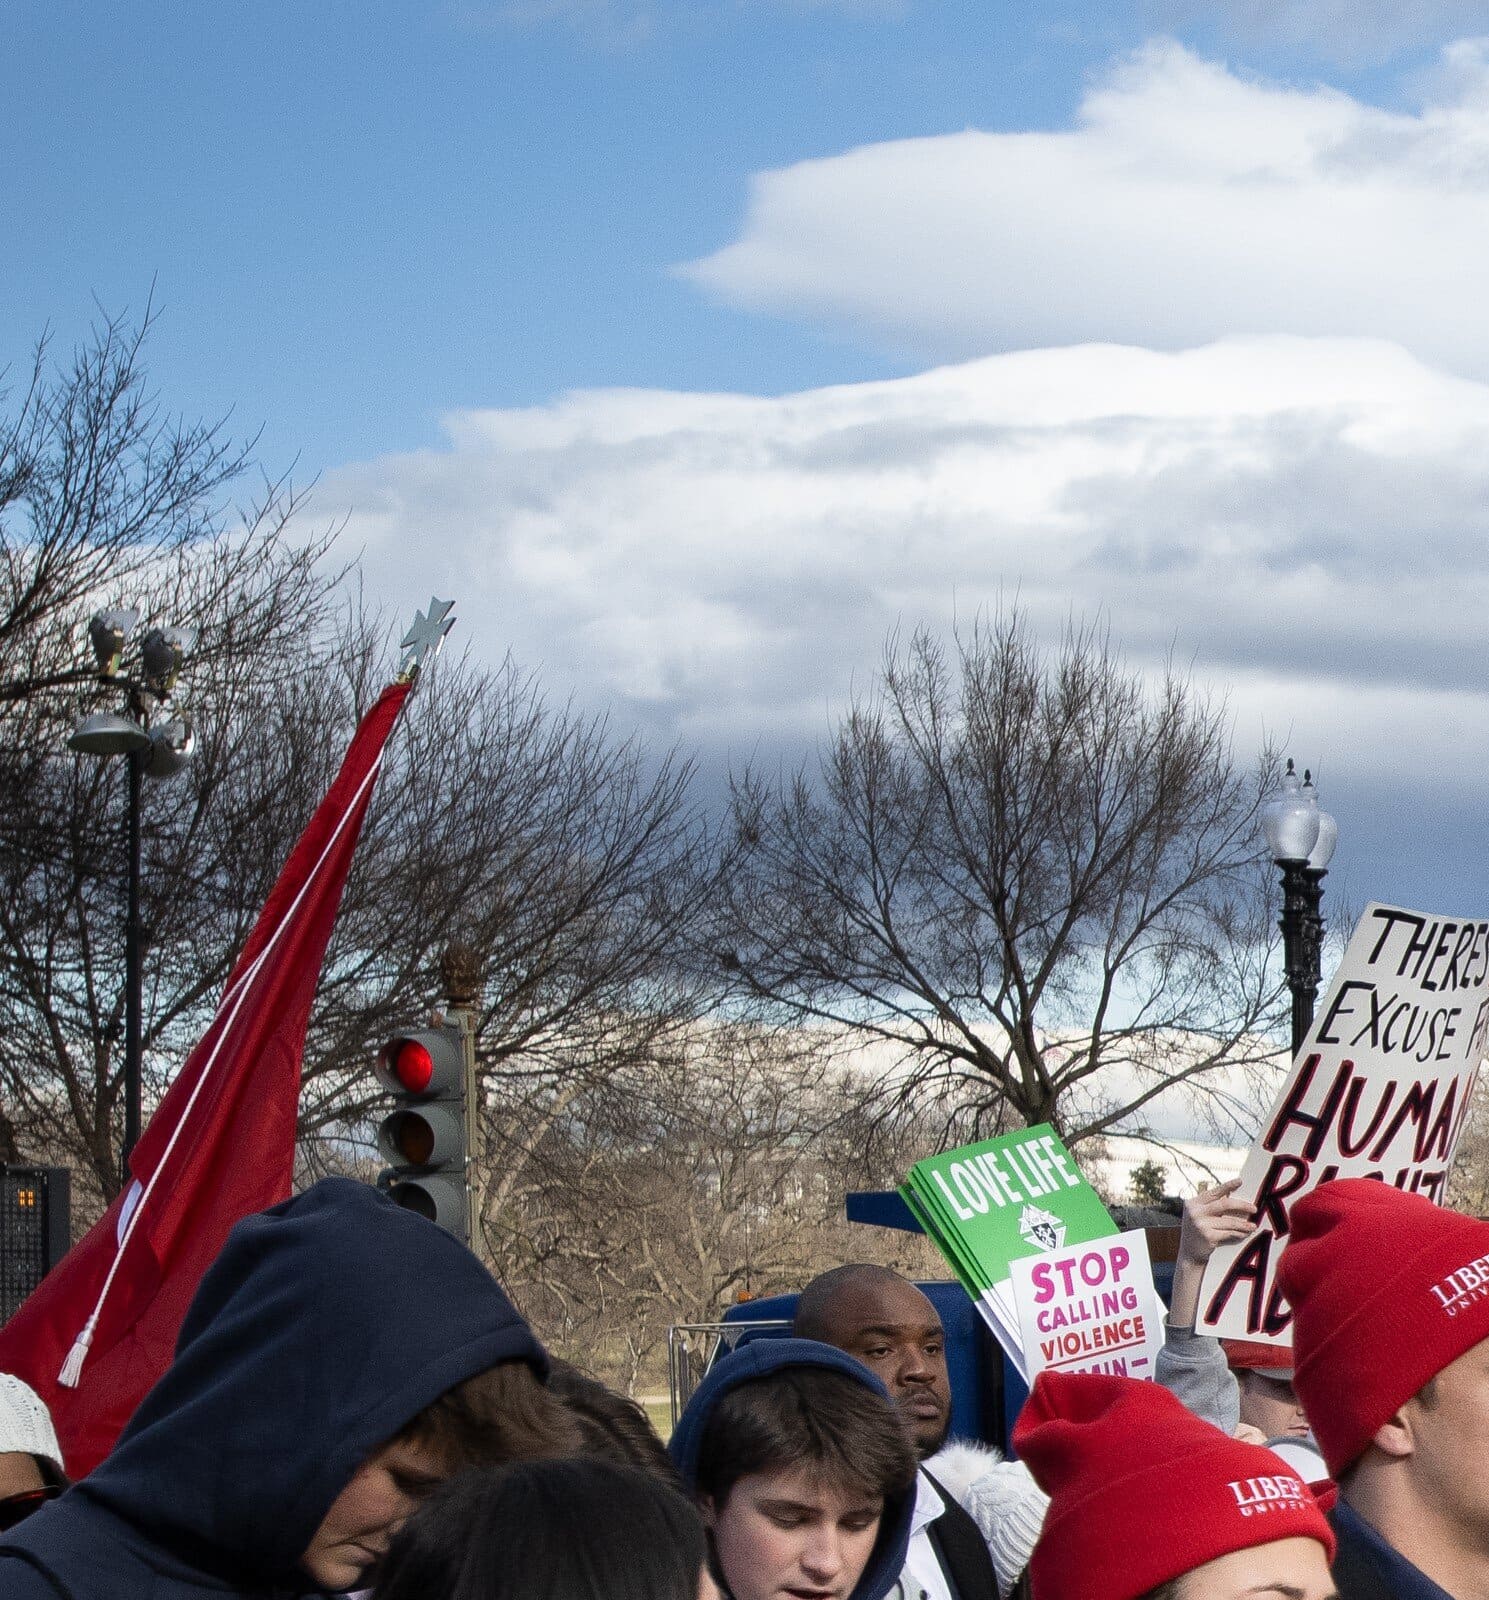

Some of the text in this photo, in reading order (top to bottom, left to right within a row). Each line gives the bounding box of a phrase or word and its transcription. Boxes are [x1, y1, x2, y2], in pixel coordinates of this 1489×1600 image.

[1316, 980, 1462, 1063] EXCUSE
[932, 1136, 1080, 1221] LOVE LIFE
[1031, 1247, 1130, 1303] STOP
[1037, 1287, 1138, 1333] CALLING
[1040, 1316, 1146, 1361] VIOLENCE
